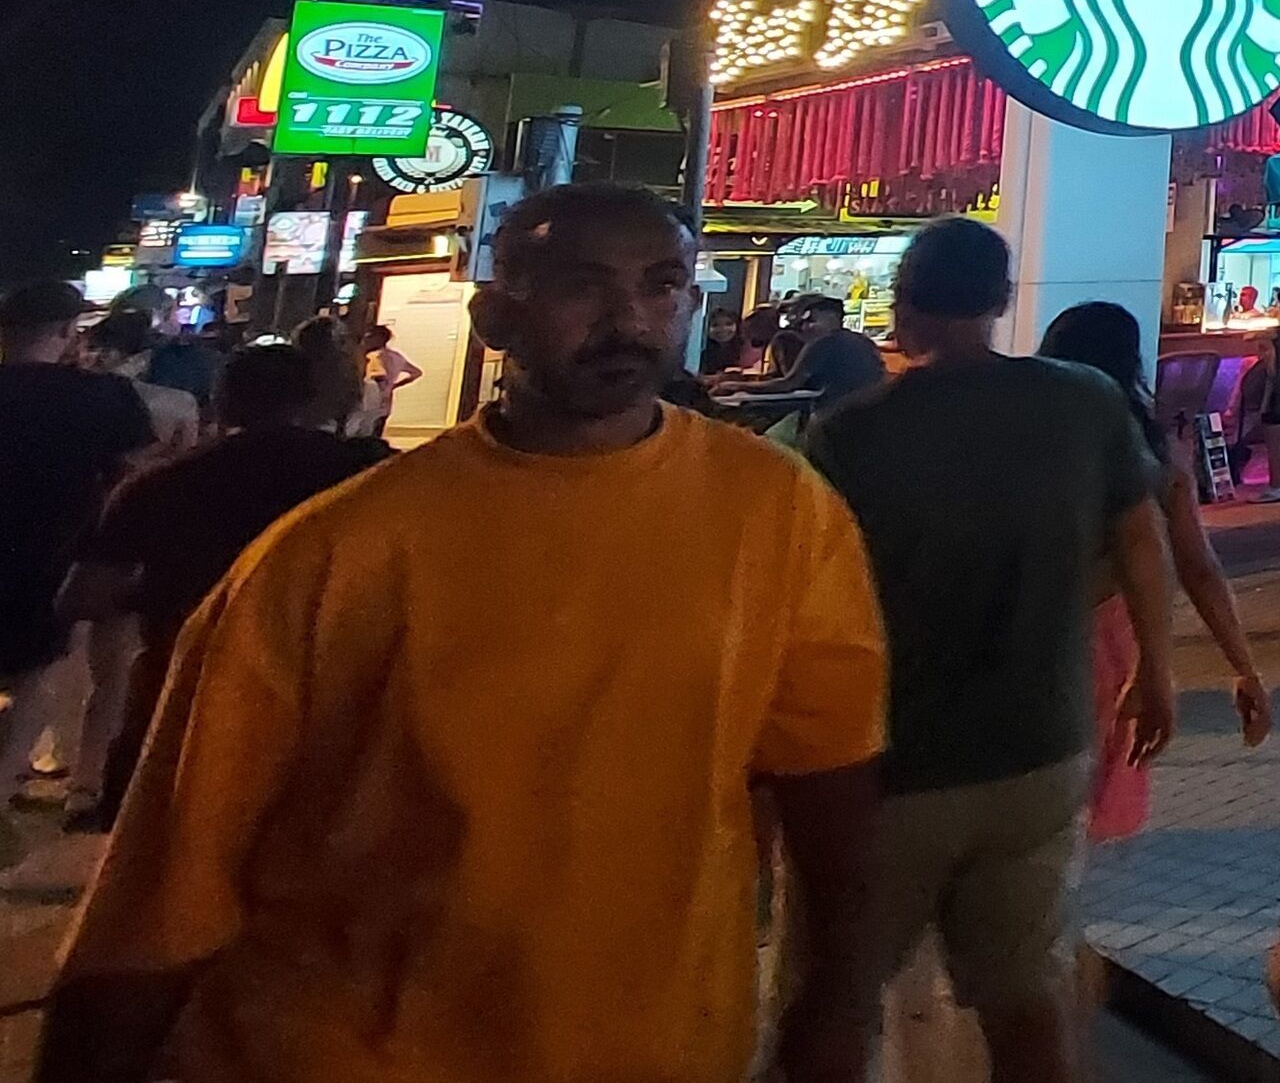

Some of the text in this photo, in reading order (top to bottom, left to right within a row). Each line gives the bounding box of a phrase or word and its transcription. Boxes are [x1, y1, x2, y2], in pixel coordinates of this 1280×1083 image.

[325, 39, 409, 60] PIZZA
[357, 33, 383, 44] The
[292, 102, 422, 126] 1112
[441, 111, 490, 151] TAVERN
